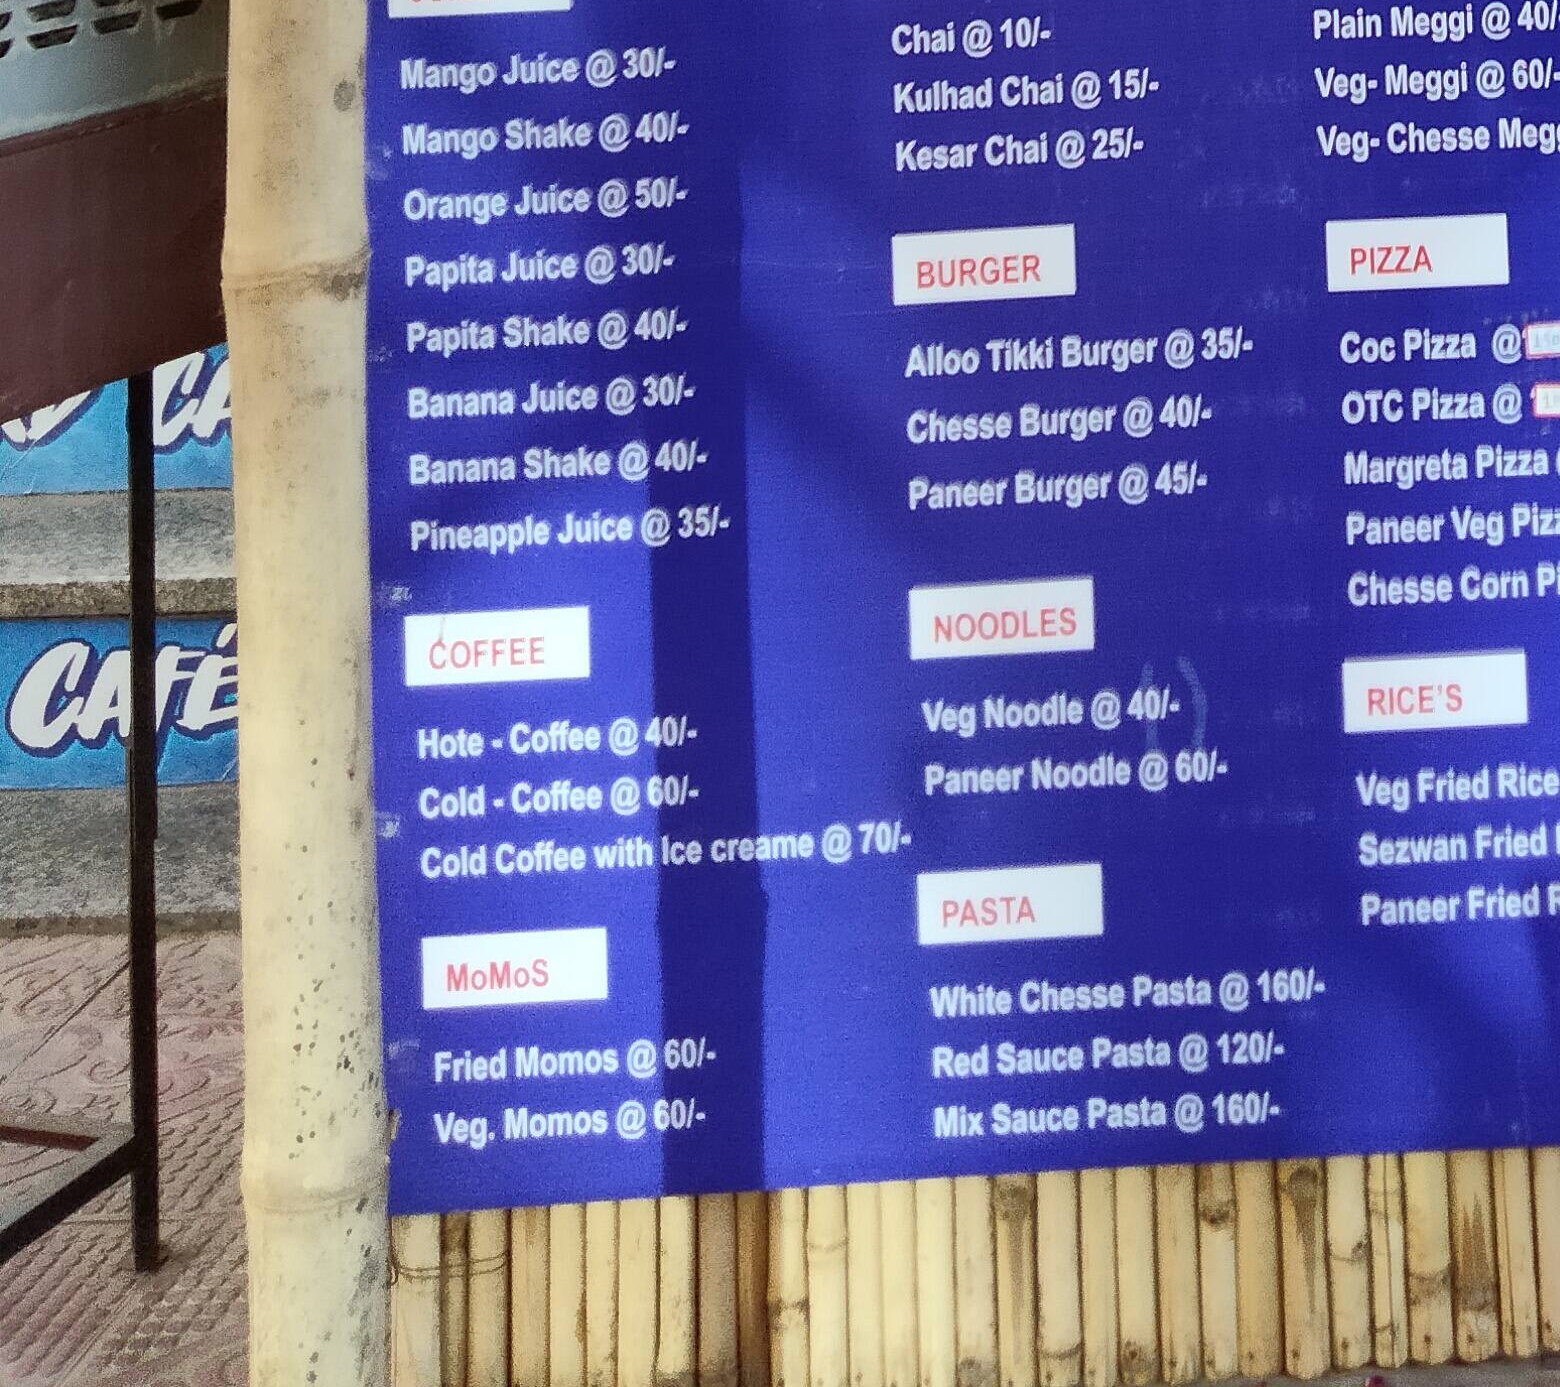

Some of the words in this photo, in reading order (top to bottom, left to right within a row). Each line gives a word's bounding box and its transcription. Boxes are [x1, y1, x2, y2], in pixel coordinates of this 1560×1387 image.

[890, 20, 956, 56] Chai
[999, 14, 1051, 48] 10/-
[1312, 7, 1382, 40] Plain
[1390, 2, 1473, 43] Meggi
[399, 57, 497, 95] Mango
[500, 51, 580, 85] Juice
[621, 45, 676, 79] 30/-
[893, 77, 993, 114] Kulhad
[999, 72, 1064, 107] Chai
[1107, 66, 1160, 100] 15/-
[915, 252, 1041, 289] BURGER
[1348, 243, 1433, 276] PIZZA
[405, 318, 496, 359] Papita
[501, 313, 591, 348] Shake
[633, 306, 687, 341] 40/-
[407, 386, 516, 419] Banana
[520, 379, 599, 414] Juice
[642, 373, 695, 407] 30/-
[905, 408, 1012, 444] Chesse
[1019, 402, 1117, 441] Burger
[1157, 392, 1212, 428] 40/-
[410, 514, 551, 555] Pineapple
[556, 510, 634, 544] Juice
[676, 504, 730, 539] 35/-
[931, 604, 1077, 642] NOODLES
[426, 635, 544, 672] COFFEE
[923, 761, 1025, 796] Paneer
[1029, 752, 1132, 791] Noodle
[1173, 748, 1228, 783] 60/-
[1354, 771, 1410, 812] Veg
[1416, 764, 1490, 803] Fried
[1496, 763, 1560, 798] Rice
[419, 843, 487, 879] Cold
[492, 839, 587, 875] Coffee
[591, 834, 654, 869] with
[660, 834, 703, 865] Ice
[709, 831, 815, 863] creame
[857, 819, 912, 854] 70/-
[940, 895, 1034, 927] PASTA
[1360, 892, 1461, 926] Paneer
[1465, 883, 1540, 920] Fried
[928, 983, 1013, 1018] White
[1018, 979, 1126, 1014] Chesse
[1131, 973, 1212, 1007] Pasta
[1256, 966, 1326, 1003] 160/-
[433, 1046, 507, 1083] Fried
[513, 1044, 619, 1078] Momos
[662, 1035, 716, 1070] 60/-
